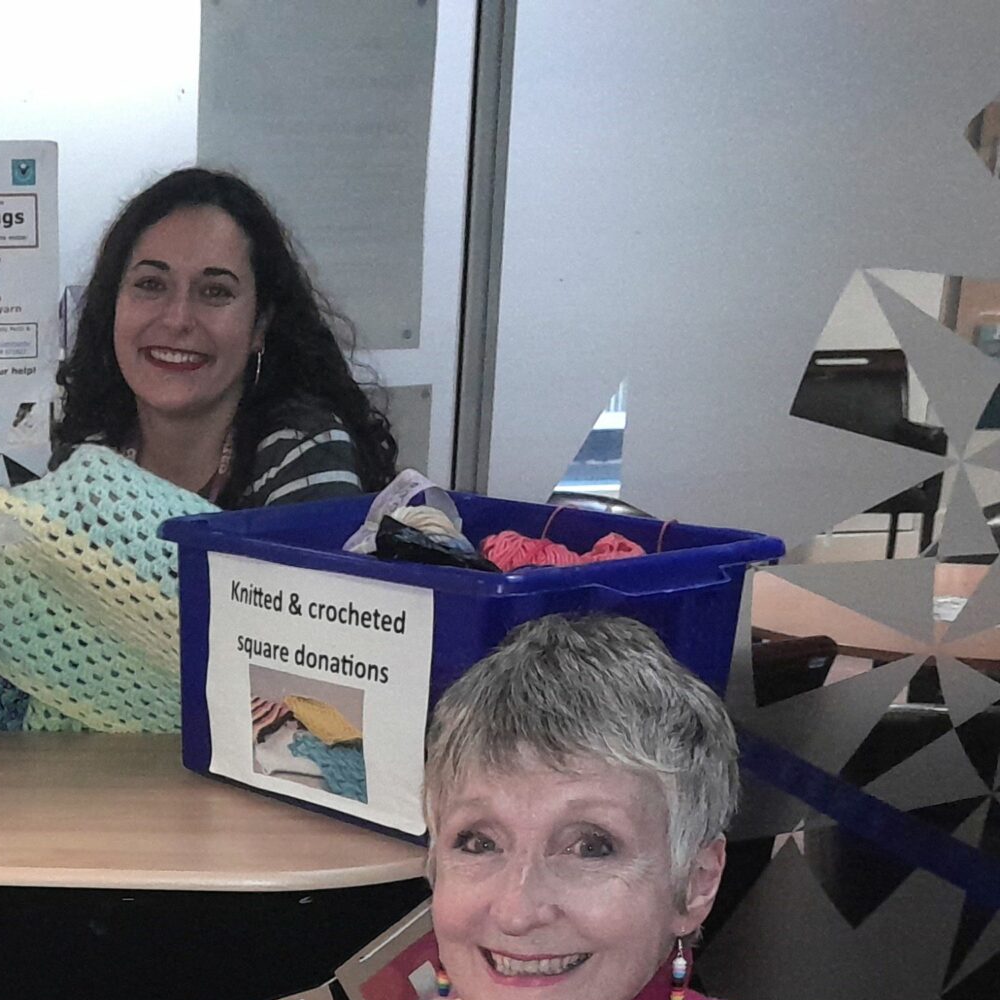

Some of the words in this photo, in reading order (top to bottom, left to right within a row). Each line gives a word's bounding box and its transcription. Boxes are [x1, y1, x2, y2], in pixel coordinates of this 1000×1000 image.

[11, 367, 36, 376] help!
[230, 580, 283, 612] Knitted
[288, 592, 302, 616] &
[308, 601, 406, 634] crocheted
[236, 633, 289, 662] square
[294, 643, 390, 684] donations
